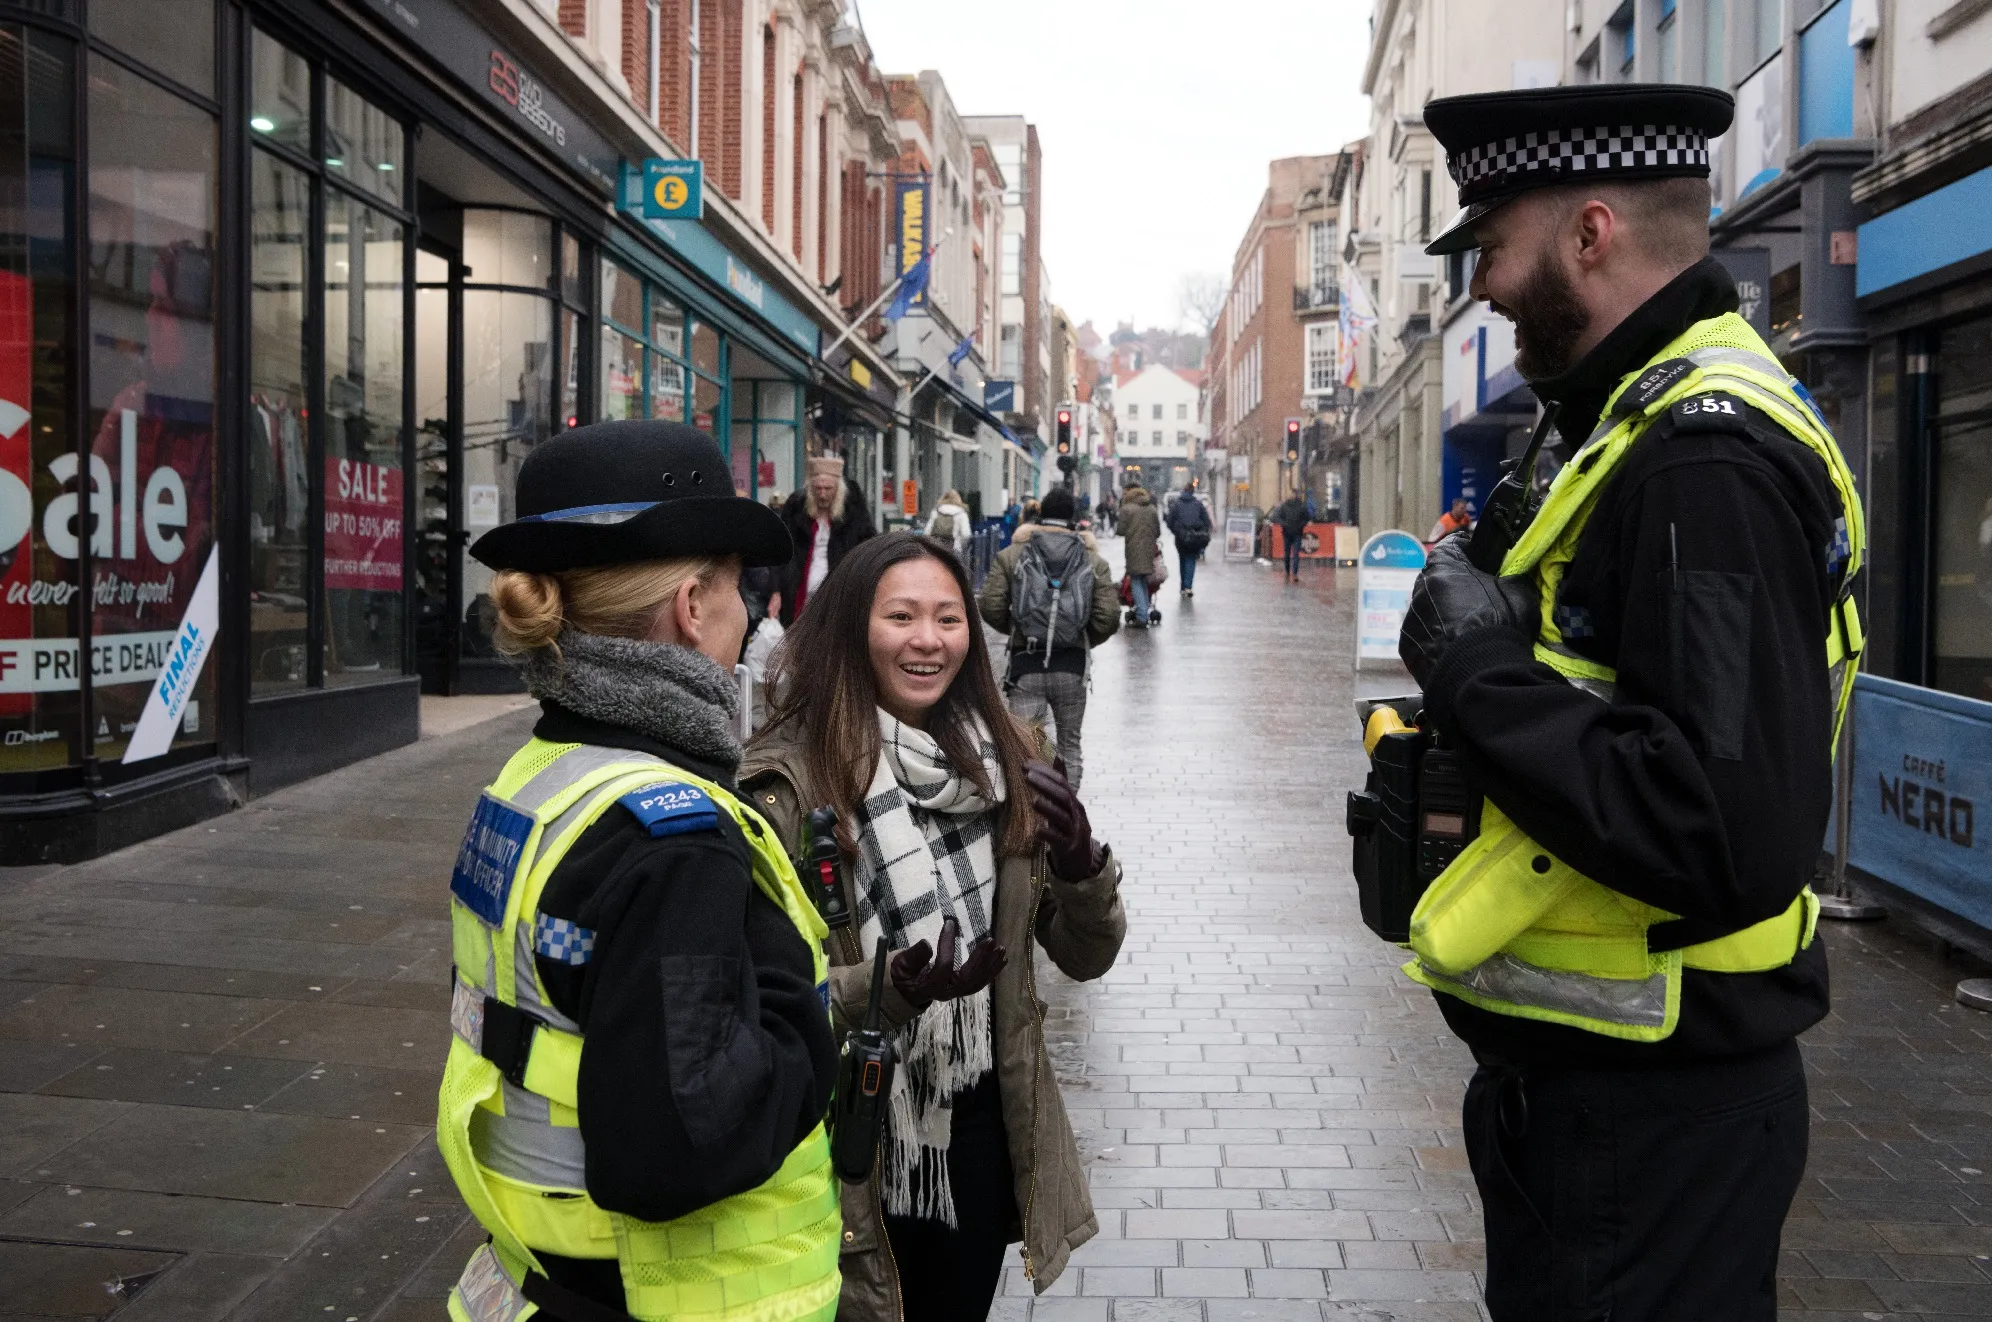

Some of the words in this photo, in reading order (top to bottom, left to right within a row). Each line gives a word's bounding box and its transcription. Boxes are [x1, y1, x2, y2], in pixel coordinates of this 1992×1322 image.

[1640, 368, 1668, 390] 851
[338, 458, 389, 504] SALE
[324, 512, 341, 534] UP
[343, 514, 358, 536] TO
[359, 516, 381, 538] 50%
[382, 518, 401, 540] OFF
[7, 580, 79, 605] never
[34, 647, 113, 680] PRICE
[119, 642, 173, 673] DEAL
[159, 621, 199, 706] FINAL
[168, 637, 206, 719] REDUCTIONS
[640, 789, 702, 810] P2243
[1879, 769, 1974, 849] NERO
